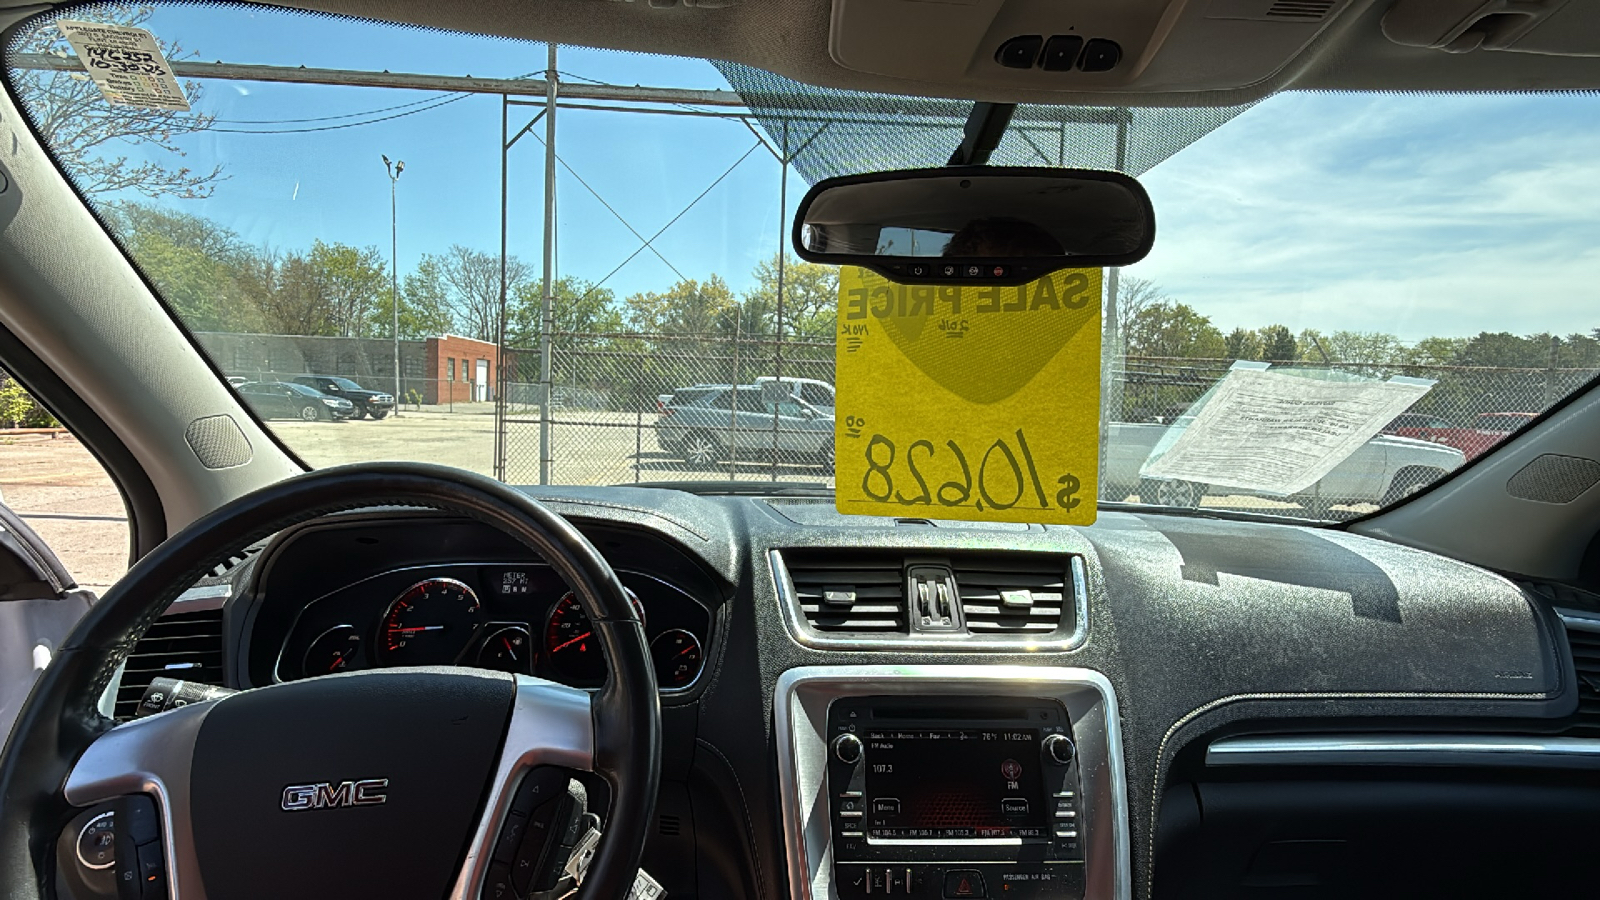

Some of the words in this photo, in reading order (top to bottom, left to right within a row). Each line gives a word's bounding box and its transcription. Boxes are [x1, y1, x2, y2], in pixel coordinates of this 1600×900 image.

[399, 640, 406, 648] 0
[873, 764, 893, 773] 107.3
[1007, 782, 1018, 790] FM
[281, 778, 389, 811] GMC
[1005, 804, 1026, 812] Source
